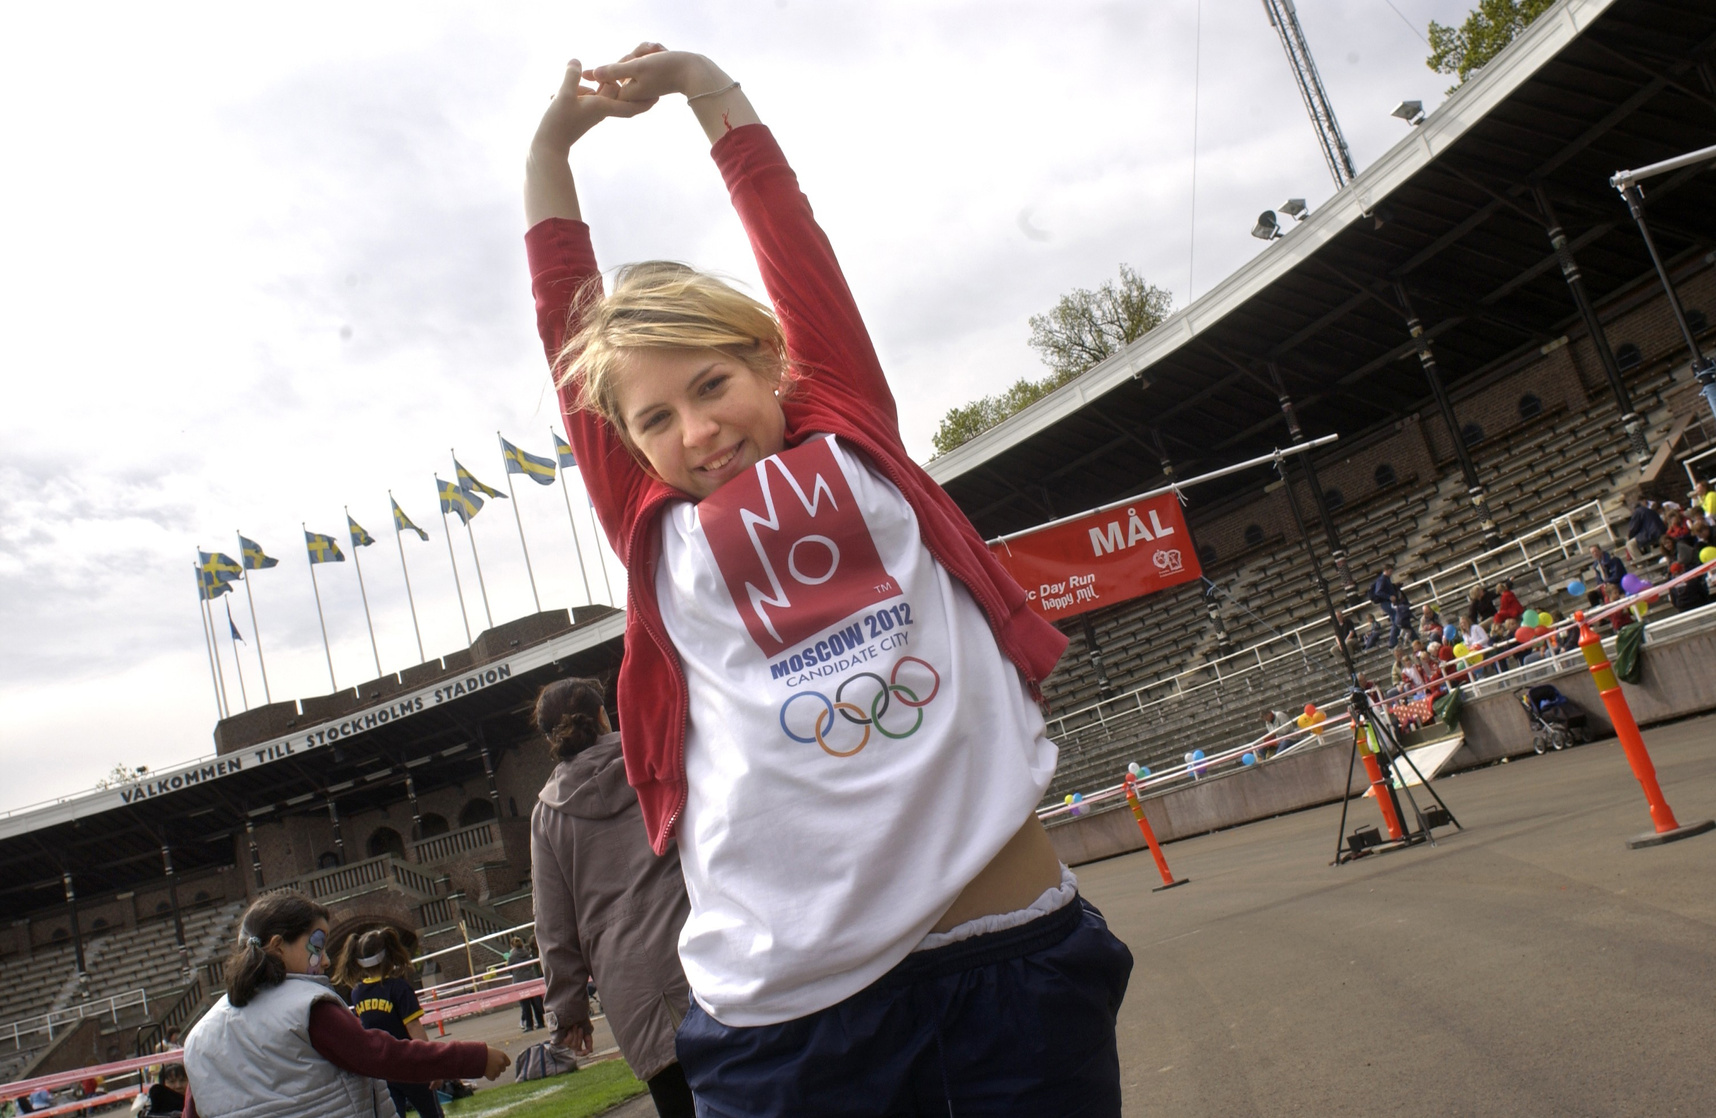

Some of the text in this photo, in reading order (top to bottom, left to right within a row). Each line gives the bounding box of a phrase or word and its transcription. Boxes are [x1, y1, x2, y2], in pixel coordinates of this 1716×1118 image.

[1088, 508, 1174, 557] MÅL
[874, 582, 892, 594] TM
[1040, 582, 1066, 597] Day
[1069, 574, 1096, 589] Run
[1041, 593, 1074, 611] happy
[770, 602, 914, 680] MOSCOW 2012
[786, 631, 909, 688] CANDIDATE CITY
[121, 663, 512, 804] VÄLKOMMEN TILL STOCKHOLMS STADION
[355, 998, 394, 1016] WEDEN
